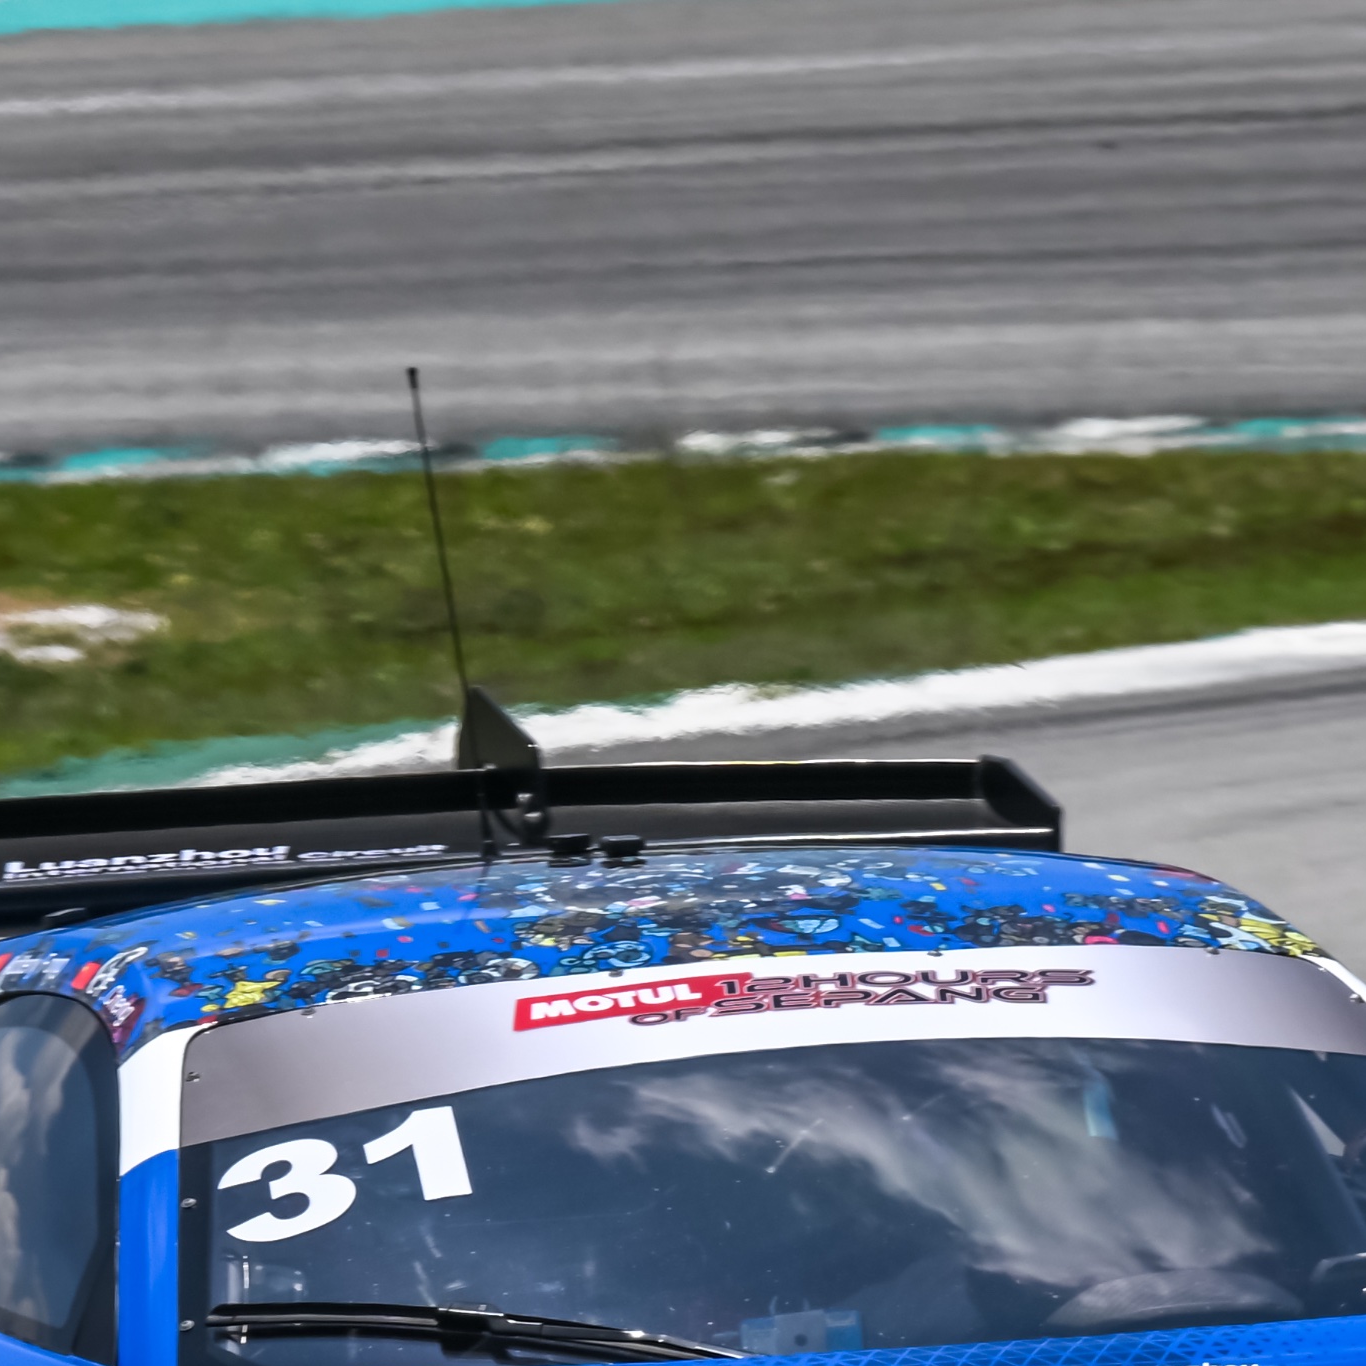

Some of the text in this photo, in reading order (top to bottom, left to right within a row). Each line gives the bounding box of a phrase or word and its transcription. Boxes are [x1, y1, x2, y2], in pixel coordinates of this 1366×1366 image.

[4, 845, 291, 872] Luanzhou
[530, 983, 703, 1021] MOTUL
[628, 985, 1048, 1027] OF SEPANG
[217, 1105, 473, 1243] 31
